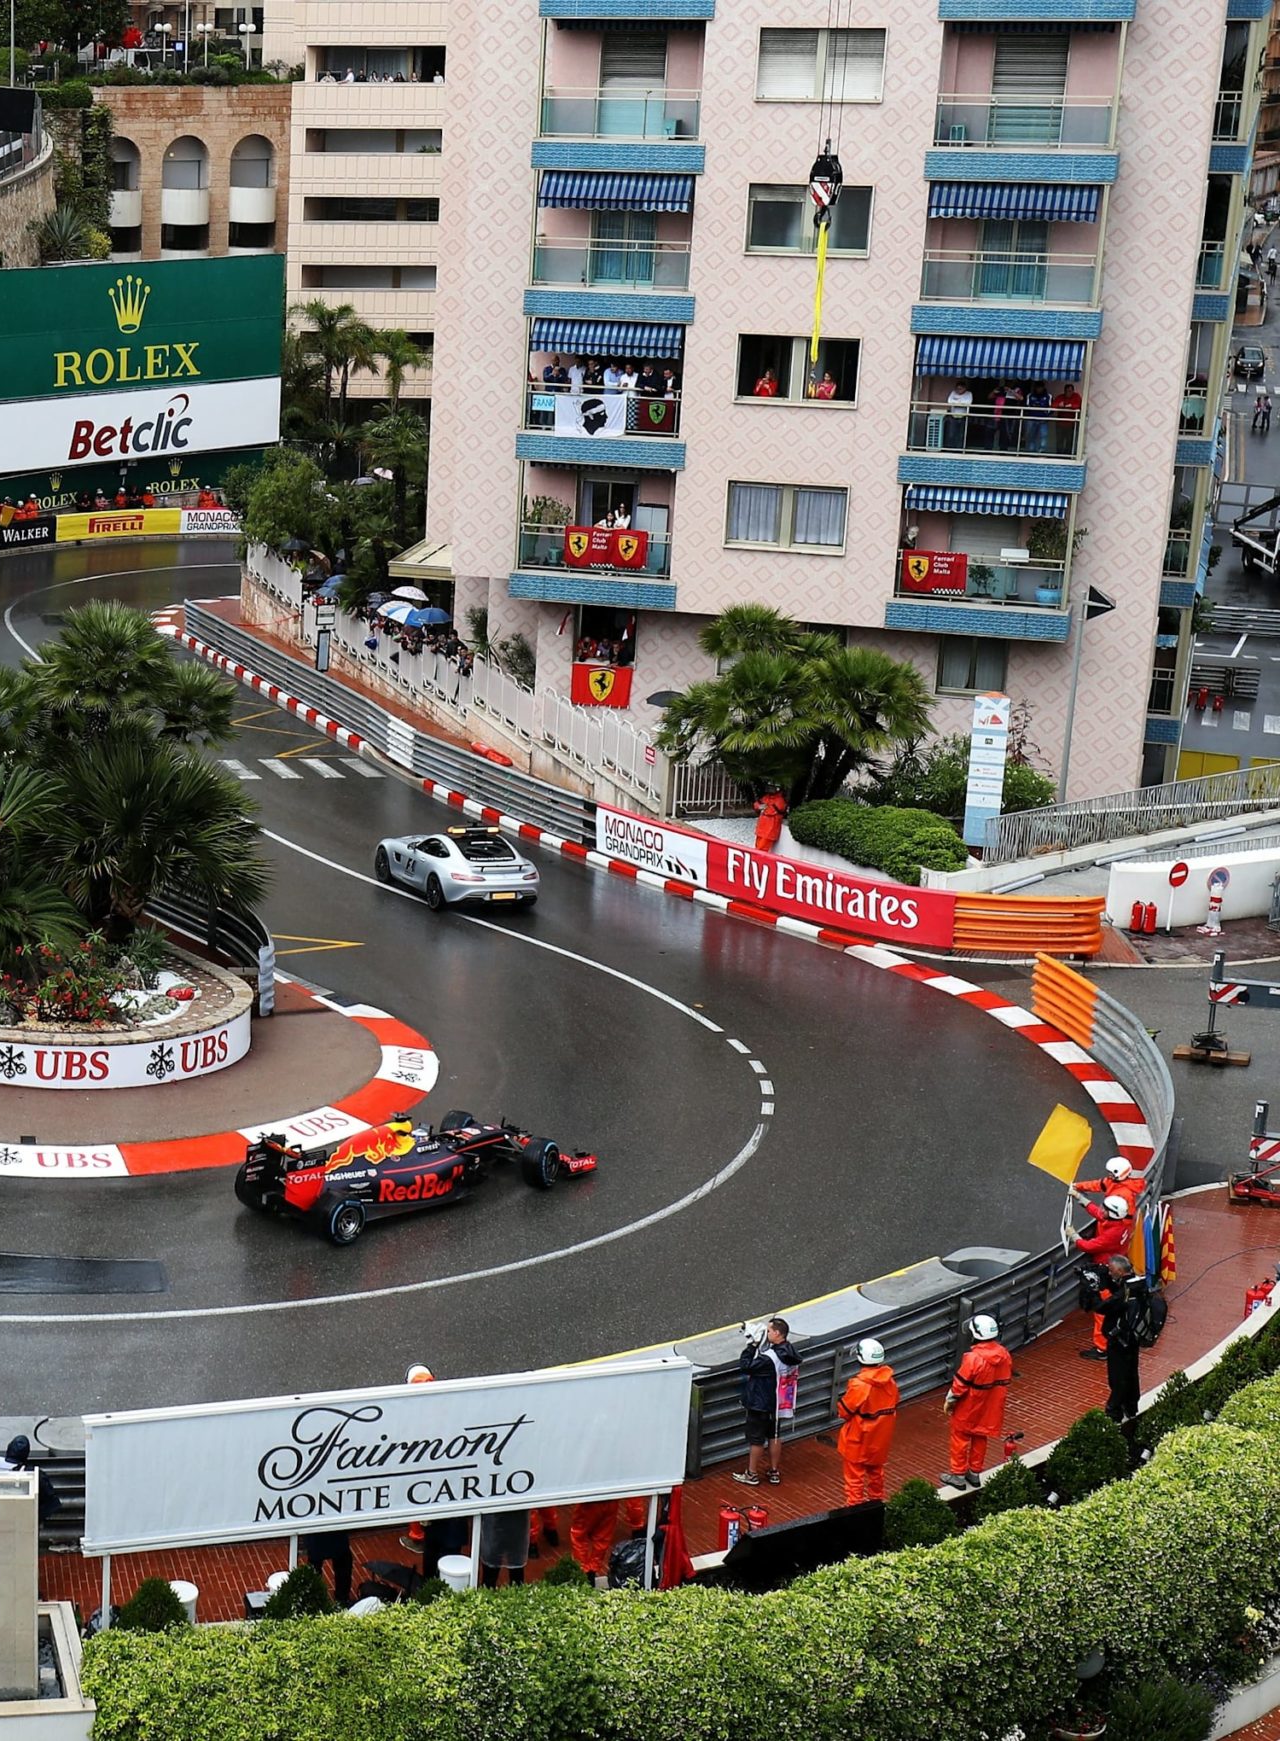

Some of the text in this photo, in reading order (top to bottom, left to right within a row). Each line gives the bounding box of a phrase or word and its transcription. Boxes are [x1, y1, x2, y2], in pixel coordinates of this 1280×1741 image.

[53, 342, 201, 388] ROLEX
[67, 404, 194, 461] Betclic
[150, 476, 201, 495] ROLEX
[2, 526, 49, 543] WALKER
[88, 514, 145, 534] PIRELLI
[604, 815, 664, 852] MONACO
[605, 835, 664, 870] GRANDPRIX
[727, 847, 920, 930] Fly Emirates
[34, 1050, 110, 1081] UBS
[180, 1029, 229, 1073] UBS
[289, 1111, 350, 1138] UBS
[36, 1152, 112, 1168] UBS
[288, 1171, 322, 1185] TOTAL
[257, 1405, 536, 1491] Fairmont
[252, 1470, 535, 1523] MONTE CARLO
